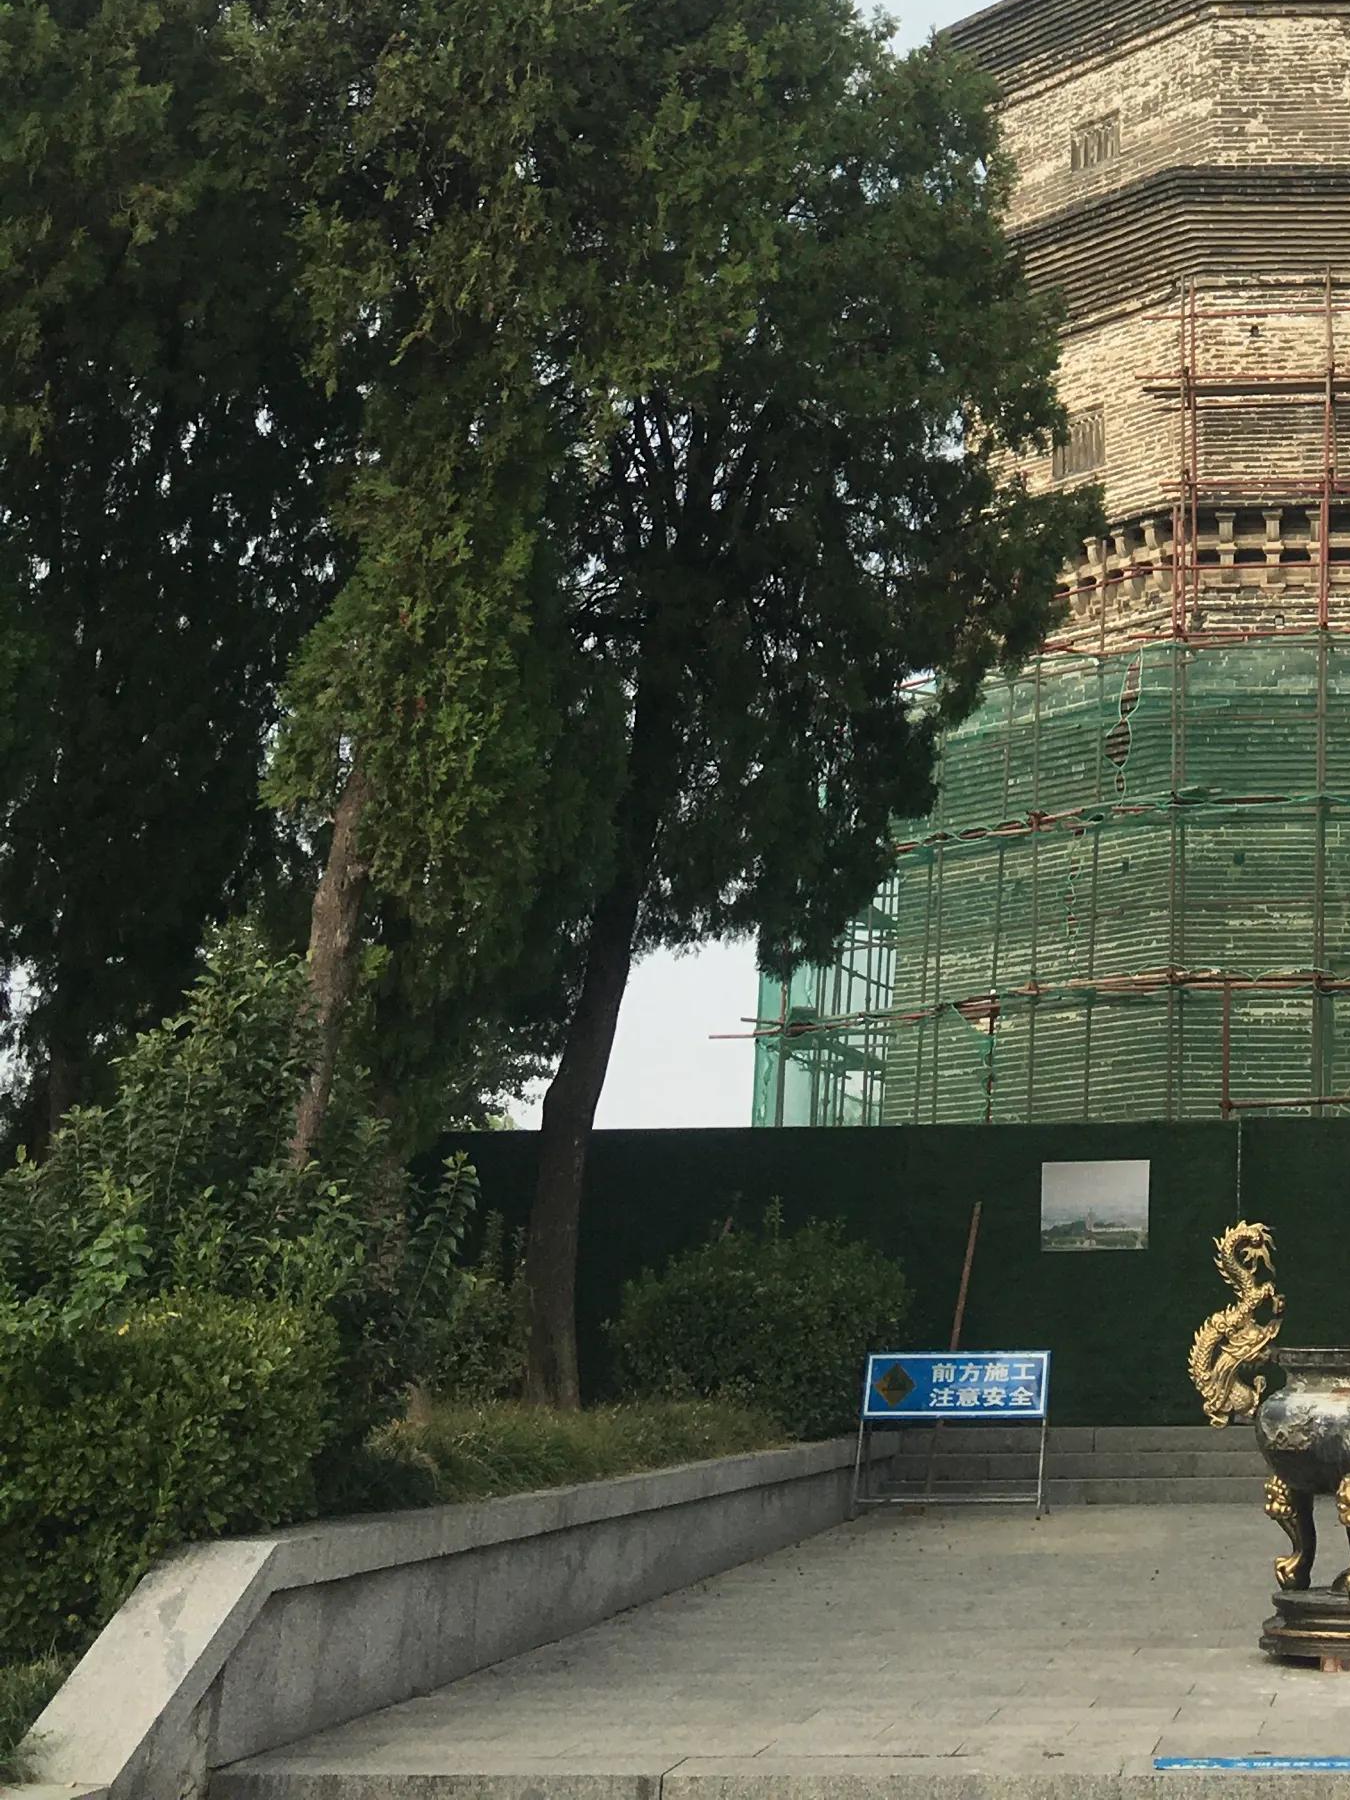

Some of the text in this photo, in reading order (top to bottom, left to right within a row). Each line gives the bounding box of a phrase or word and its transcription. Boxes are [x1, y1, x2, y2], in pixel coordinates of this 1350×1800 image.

[932, 1363, 1036, 1383] 前方施工
[929, 1387, 1034, 1406] 注意安全
